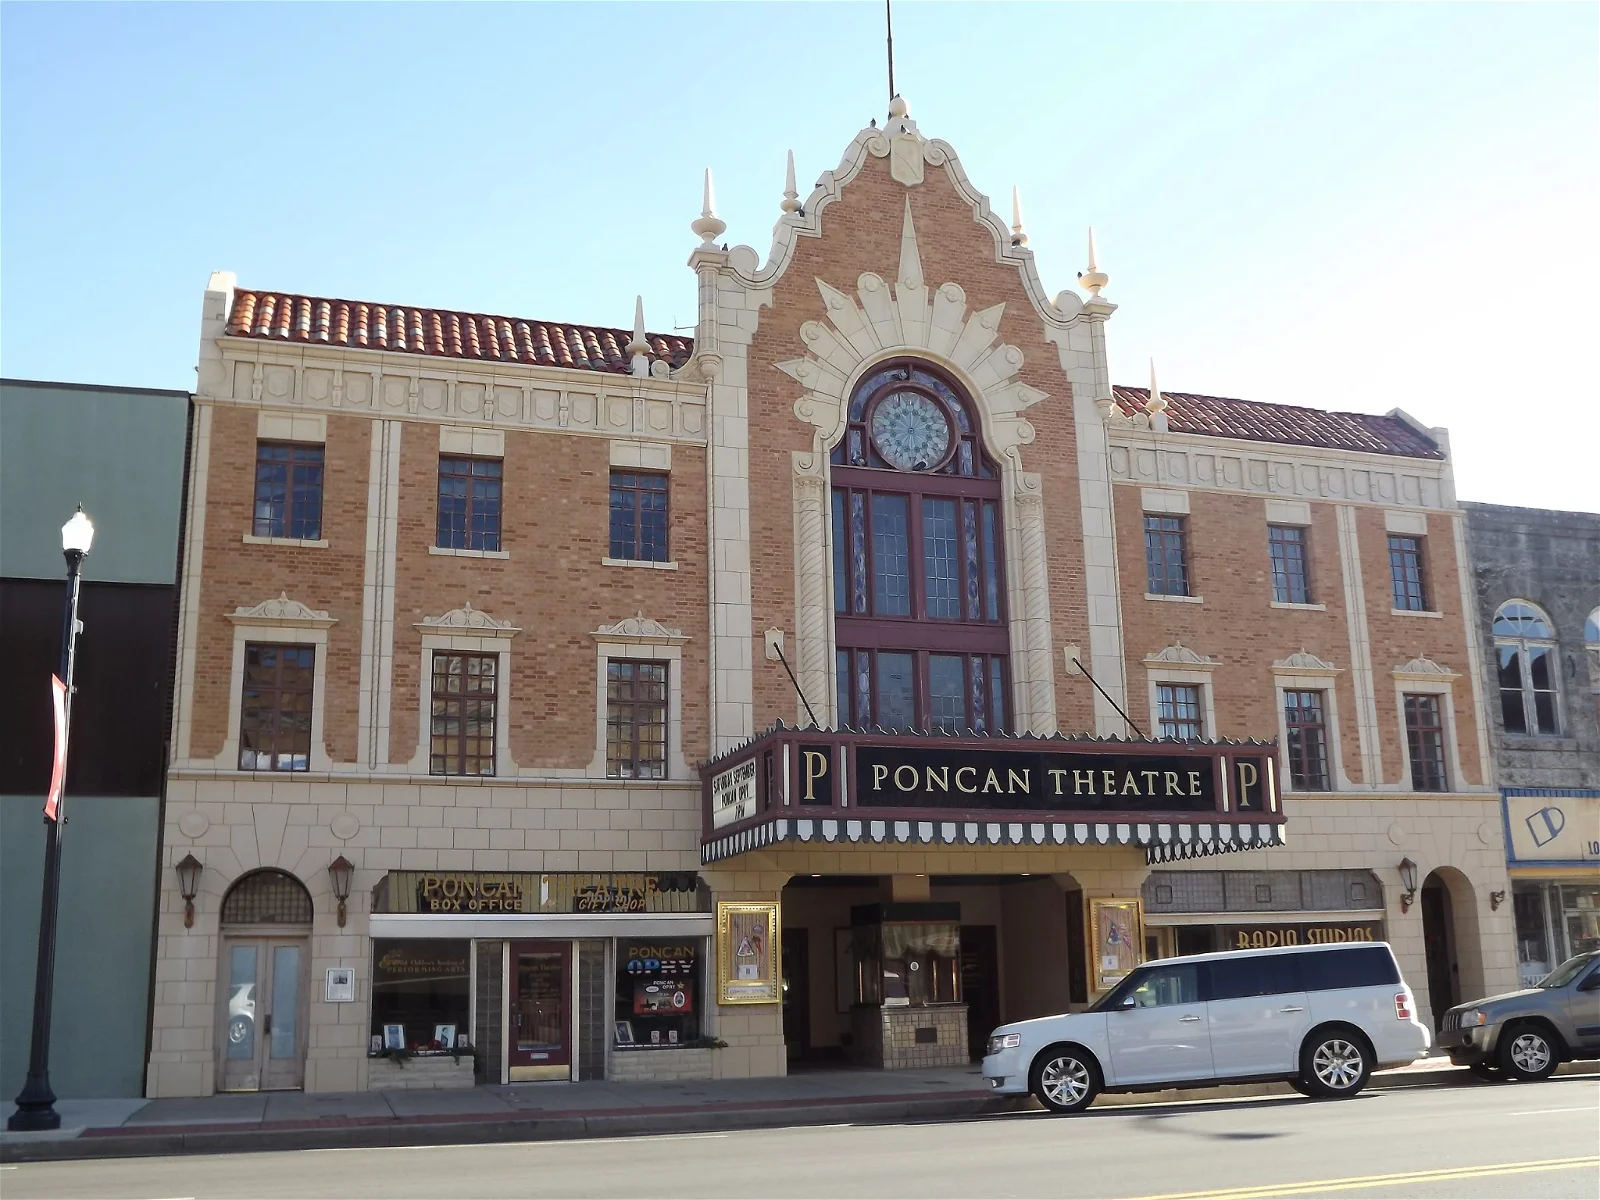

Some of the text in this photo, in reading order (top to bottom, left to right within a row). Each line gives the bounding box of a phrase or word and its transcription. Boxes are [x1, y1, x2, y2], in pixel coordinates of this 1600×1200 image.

[803, 751, 828, 800] P
[872, 764, 1202, 796] PONCAN THEATRE
[1236, 762, 1258, 807] P
[422, 873, 660, 899] PONCAN THEATRE
[430, 900, 522, 910] BOX OFFICE
[579, 898, 647, 910] GIFT SHOP
[1236, 927, 1374, 948] RADIO STUDIOS
[628, 946, 695, 959] PONCAN
[627, 959, 694, 974] OPRY
